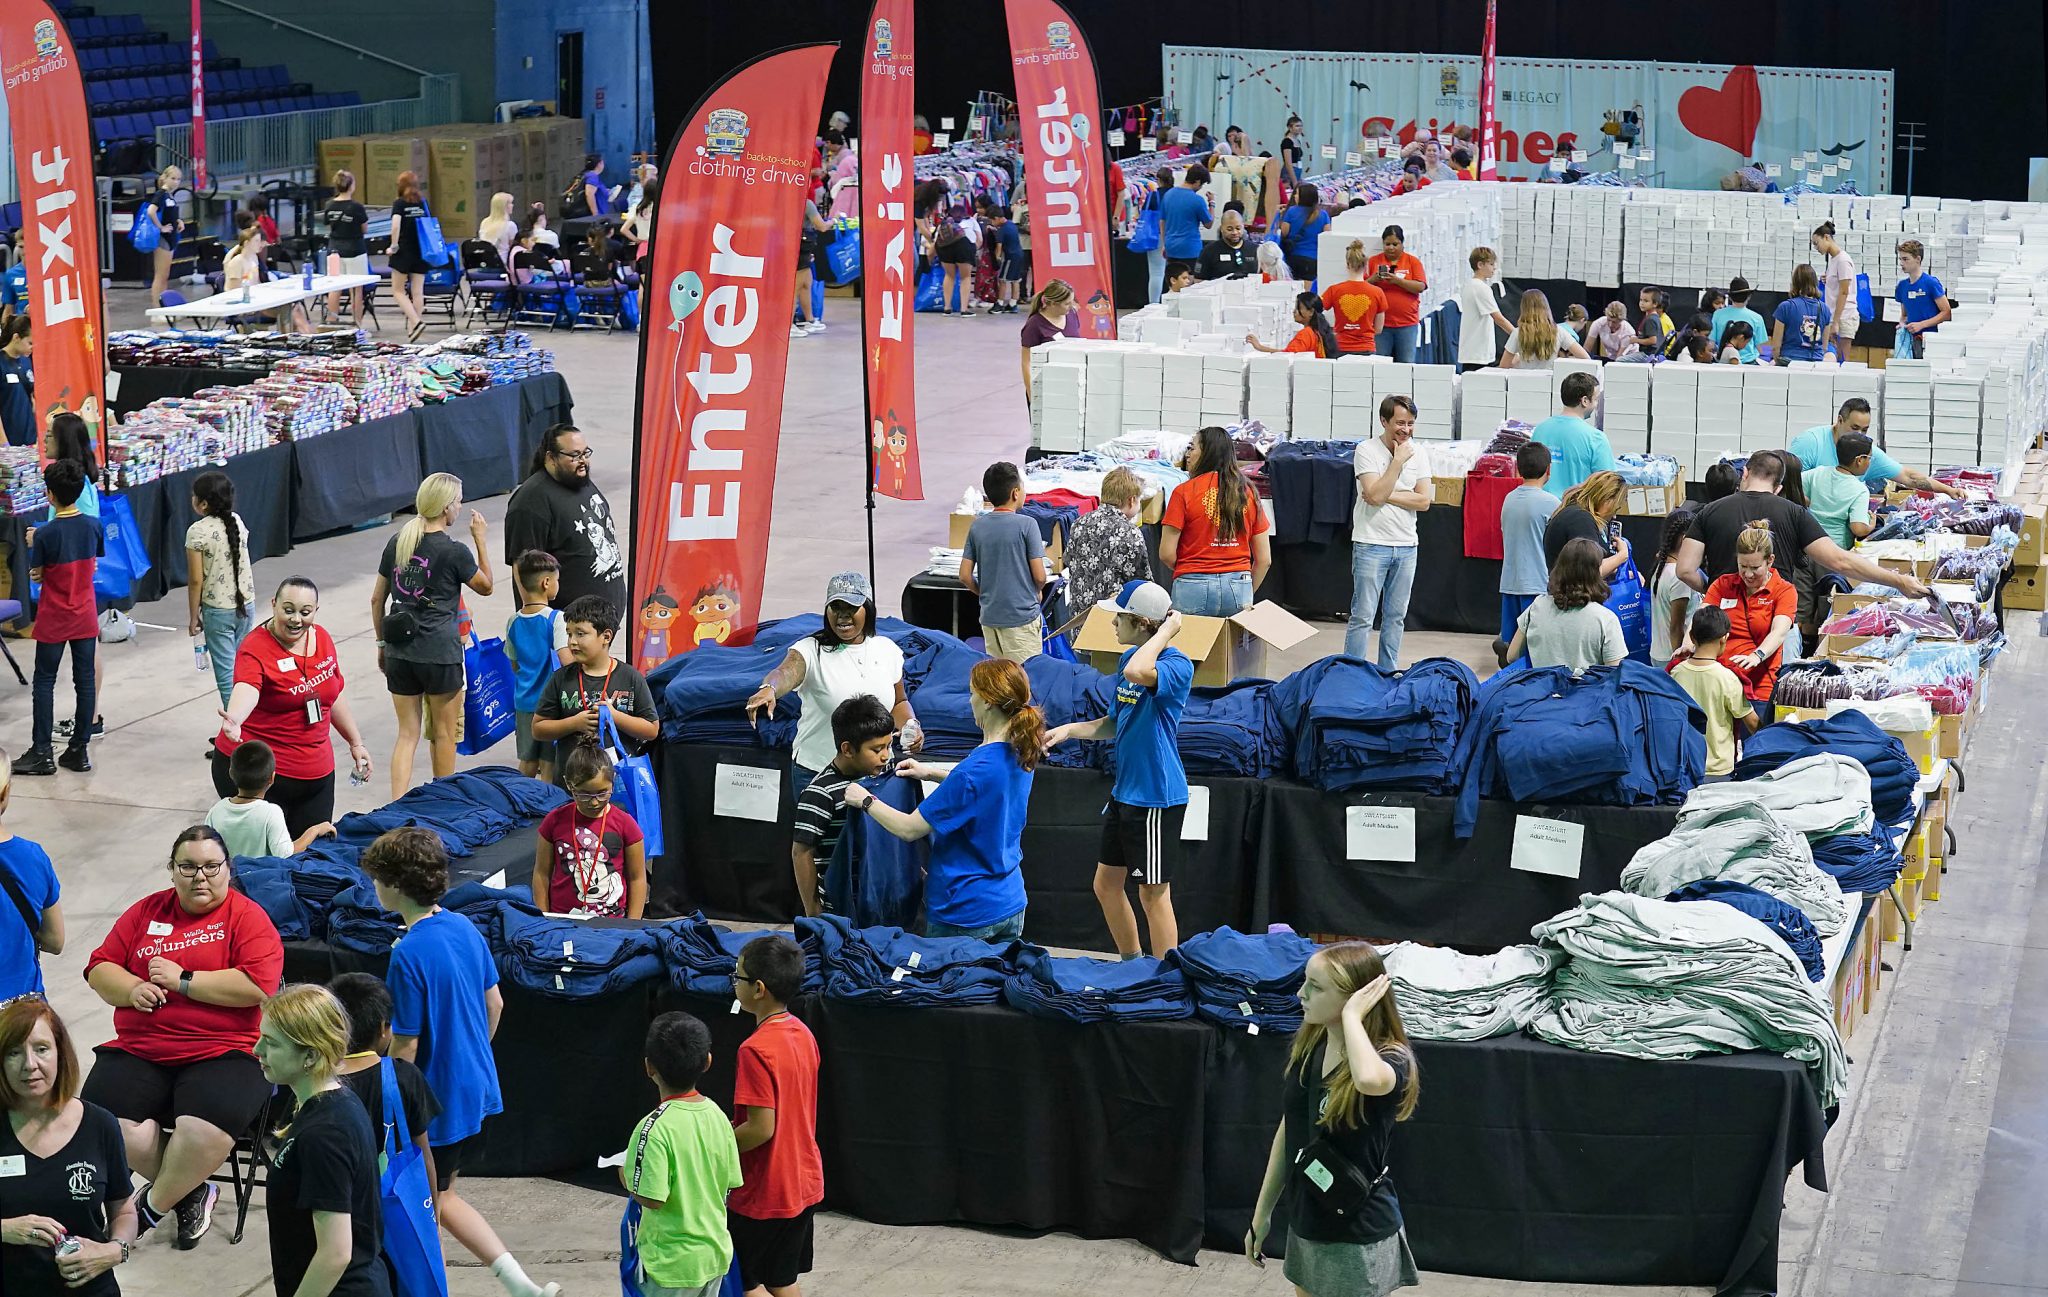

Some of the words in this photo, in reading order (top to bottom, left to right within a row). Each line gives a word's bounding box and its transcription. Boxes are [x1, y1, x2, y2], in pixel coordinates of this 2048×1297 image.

[1513, 90, 1561, 104] LEGACY
[688, 156, 756, 185] clothing
[762, 165, 806, 187] drive
[746, 151, 807, 169] back-to-school
[667, 222, 765, 541] Enter
[206, 921, 225, 931] argo
[637, 1117, 656, 1161] MINECRAFT
